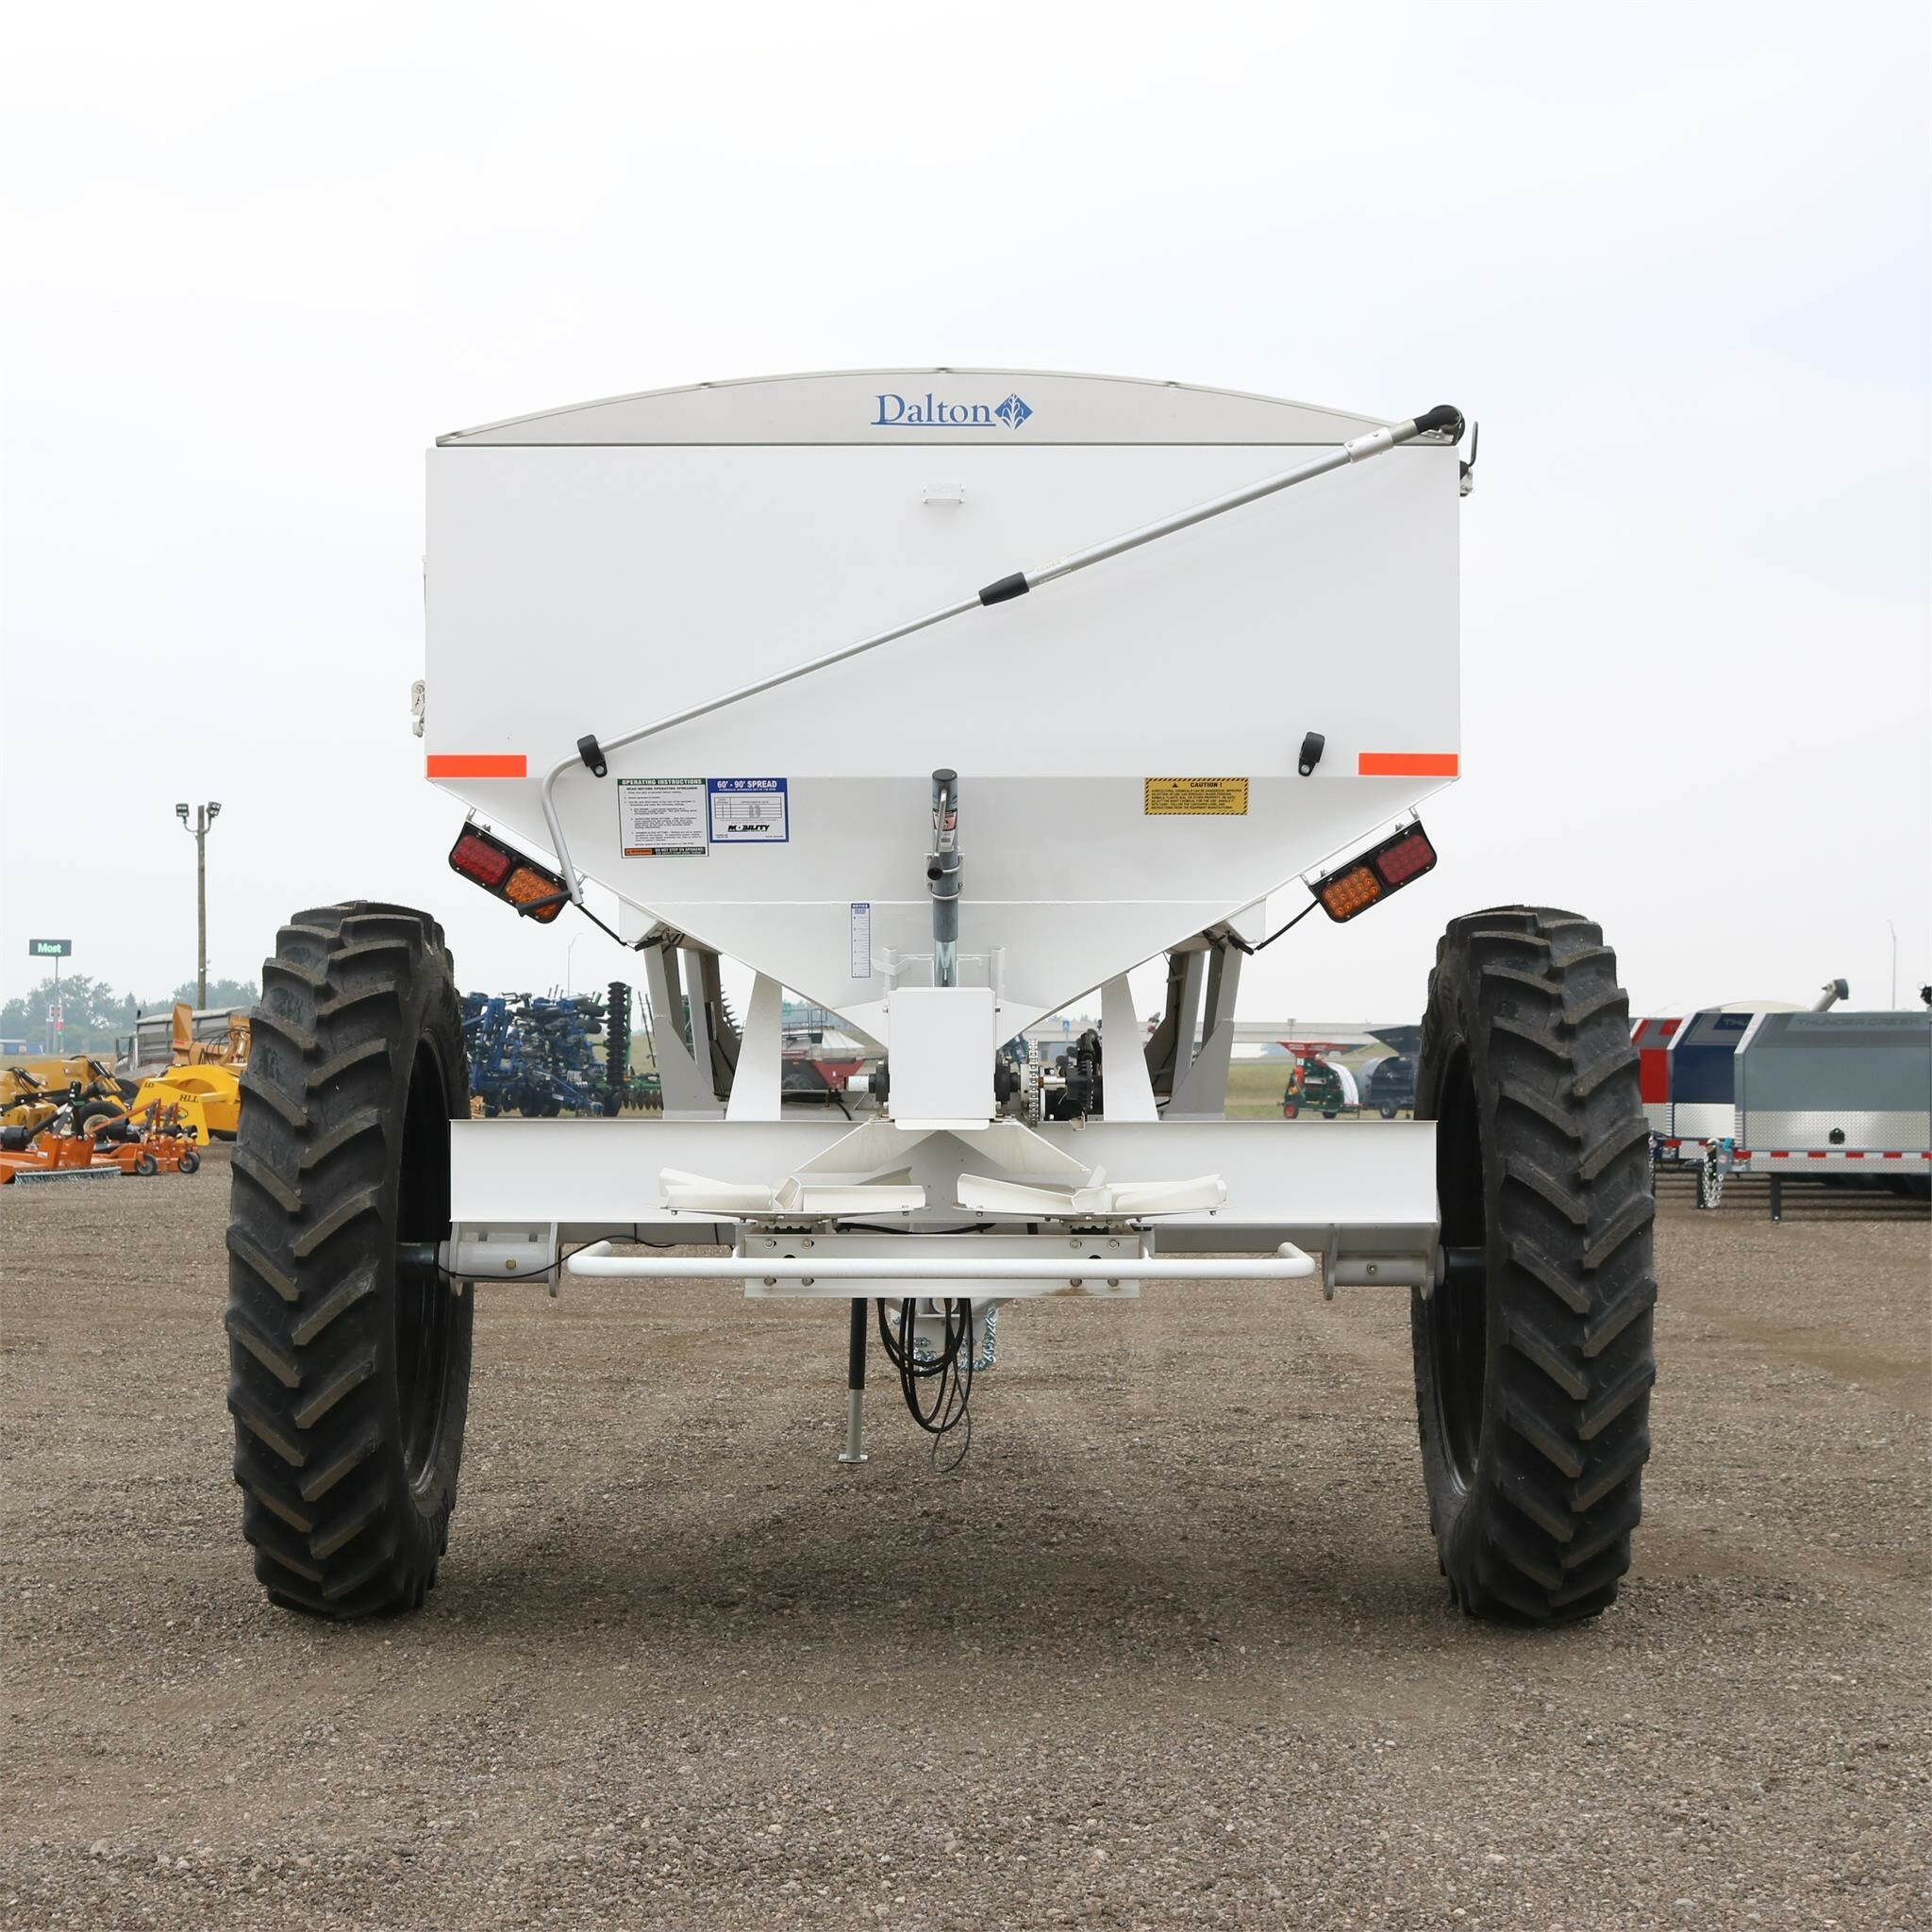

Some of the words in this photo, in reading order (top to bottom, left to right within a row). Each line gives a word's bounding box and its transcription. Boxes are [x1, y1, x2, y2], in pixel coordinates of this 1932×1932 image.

[874, 392, 993, 425] Dalton
[747, 780, 777, 789] SPREAD
[38, 942, 62, 953] Most
[1796, 1018, 1864, 1026] THUNDER
[1867, 1018, 1921, 1026] CREEK
